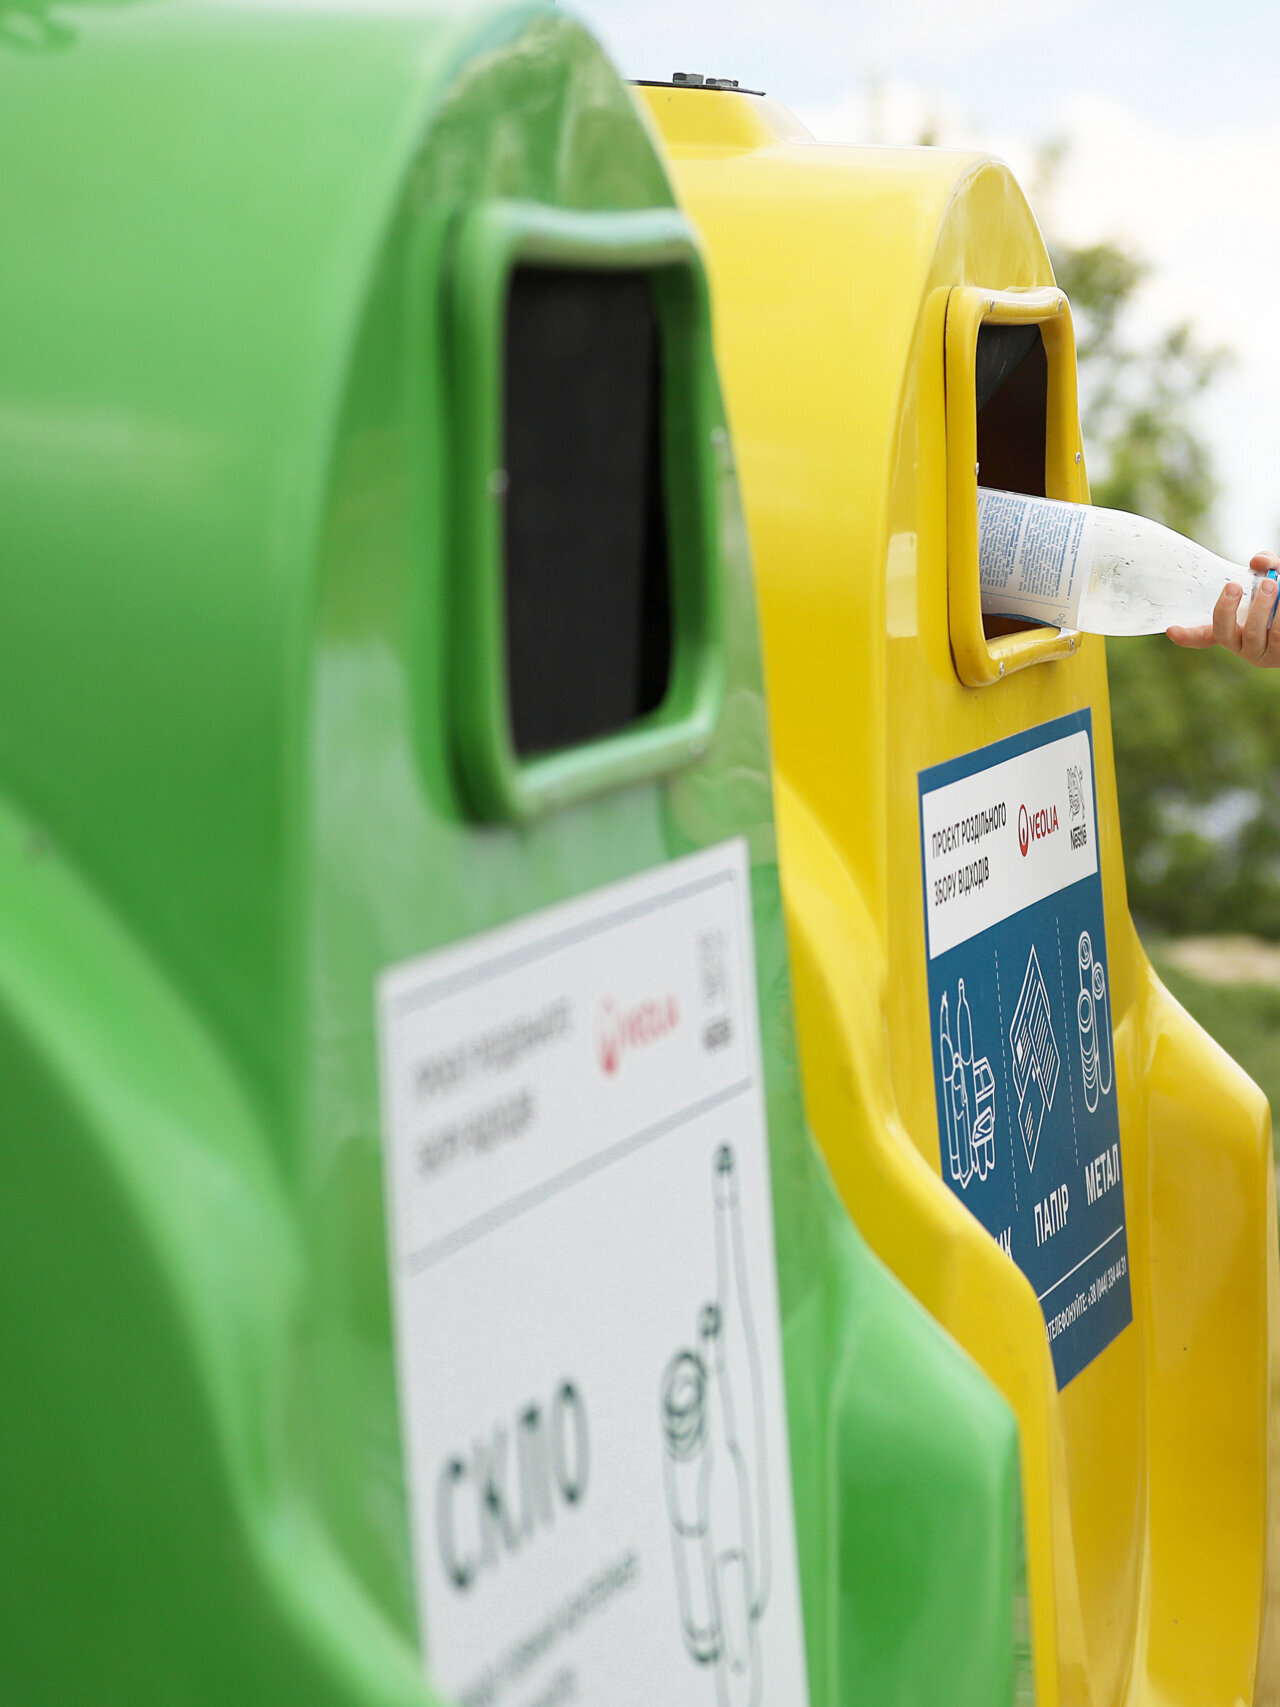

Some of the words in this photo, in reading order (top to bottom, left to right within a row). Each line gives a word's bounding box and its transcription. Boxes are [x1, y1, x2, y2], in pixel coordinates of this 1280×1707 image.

[961, 801, 1007, 848] РОЗДІЛЬНОГО
[1028, 804, 1060, 842] VEOLIA
[934, 872, 957, 906] ЗБОРУ
[958, 856, 990, 897] ВІДХОДІВ
[1084, 1143, 1121, 1206] МЕТАЛ
[1033, 1183, 1070, 1248] ПАПІР
[436, 1374, 590, 1594] СКЛО
